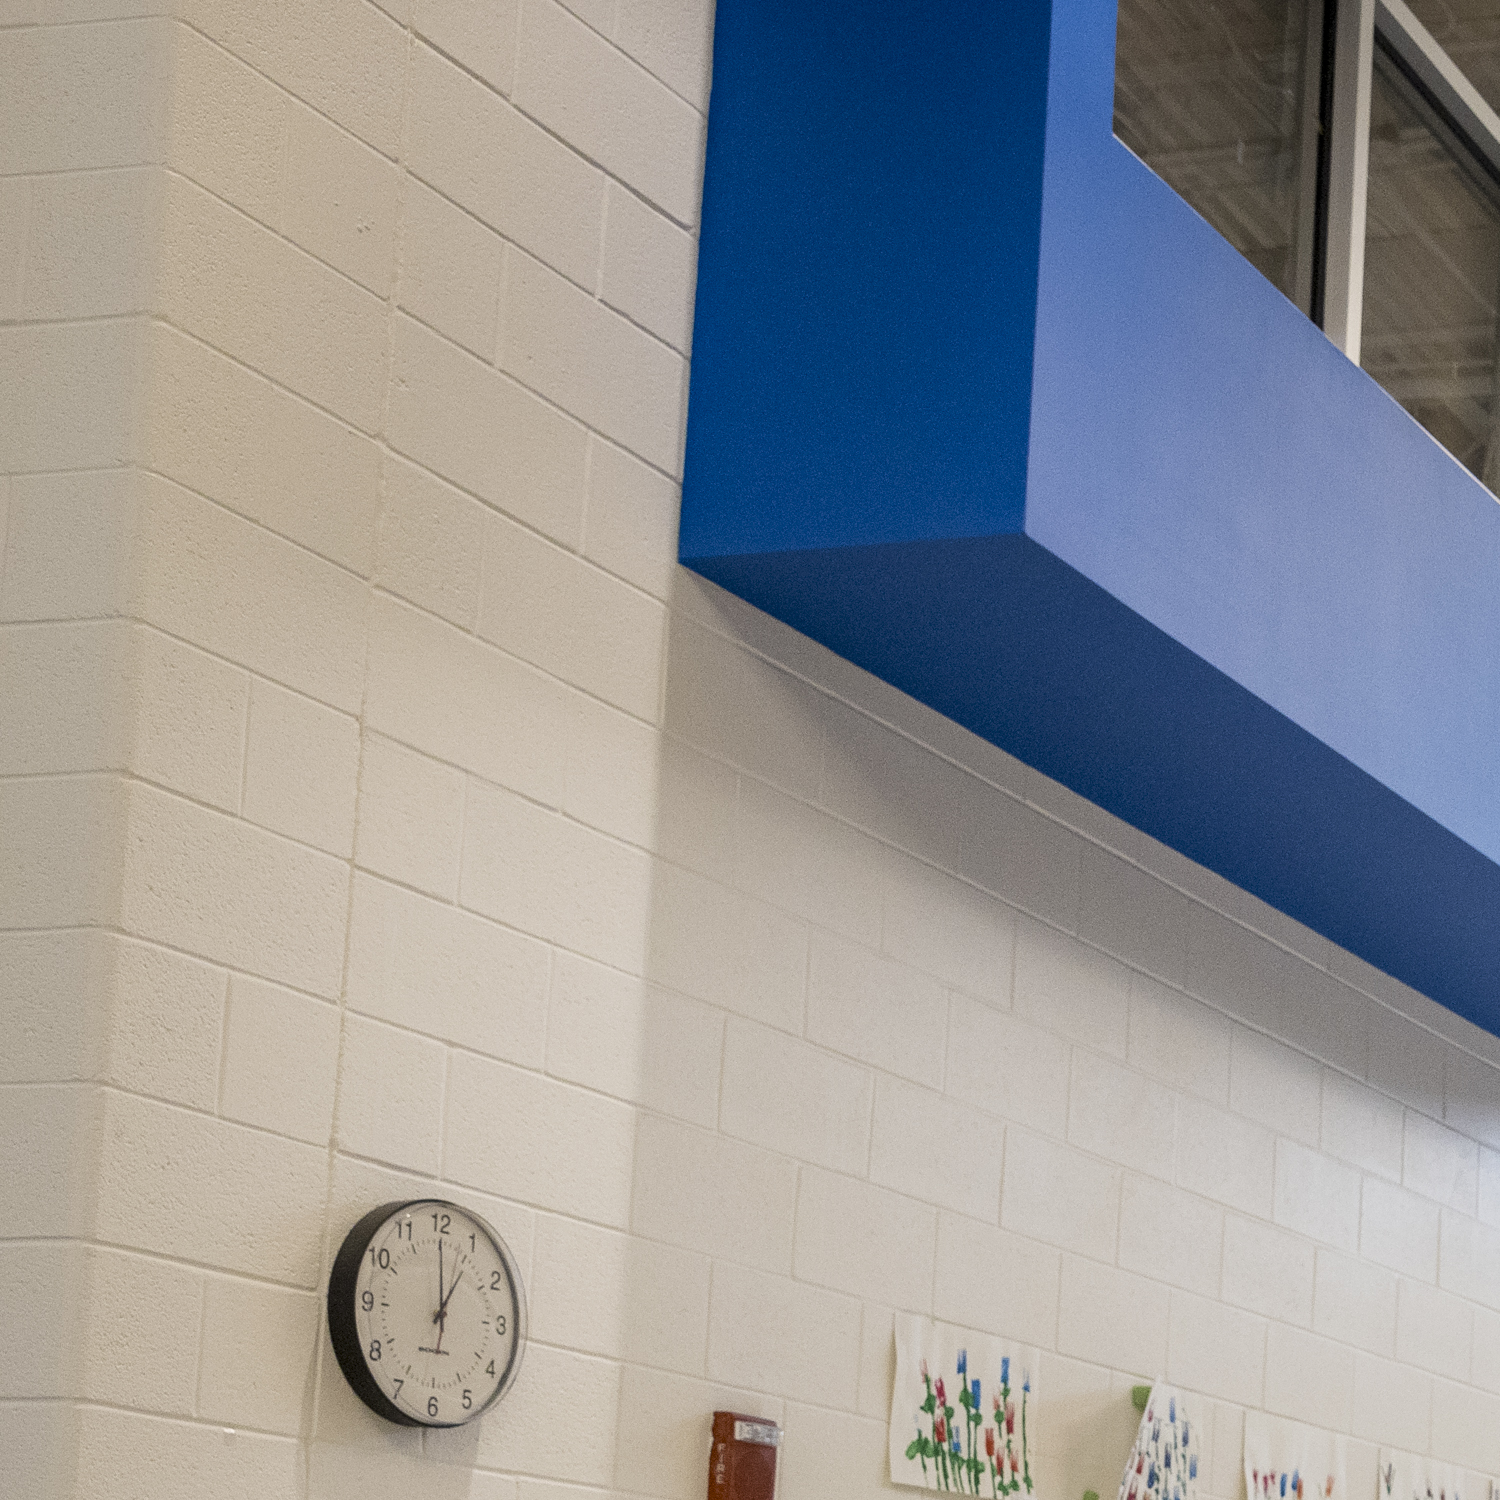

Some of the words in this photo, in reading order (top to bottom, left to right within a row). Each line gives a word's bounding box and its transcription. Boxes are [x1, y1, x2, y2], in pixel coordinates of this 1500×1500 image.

[396, 1220, 412, 1241] 11
[432, 1213, 450, 1235] 12
[469, 1233, 476, 1253] 1
[369, 1246, 390, 1269] 10
[490, 1270, 501, 1291] 2
[361, 1290, 374, 1312] 9
[495, 1315, 507, 1335] 3
[369, 1339, 382, 1361] 8
[485, 1359, 496, 1378] 4
[393, 1378, 404, 1400] 7
[461, 1389, 472, 1409] 5
[427, 1396, 438, 1416] 6
[716, 1442, 727, 1485] FIRE
